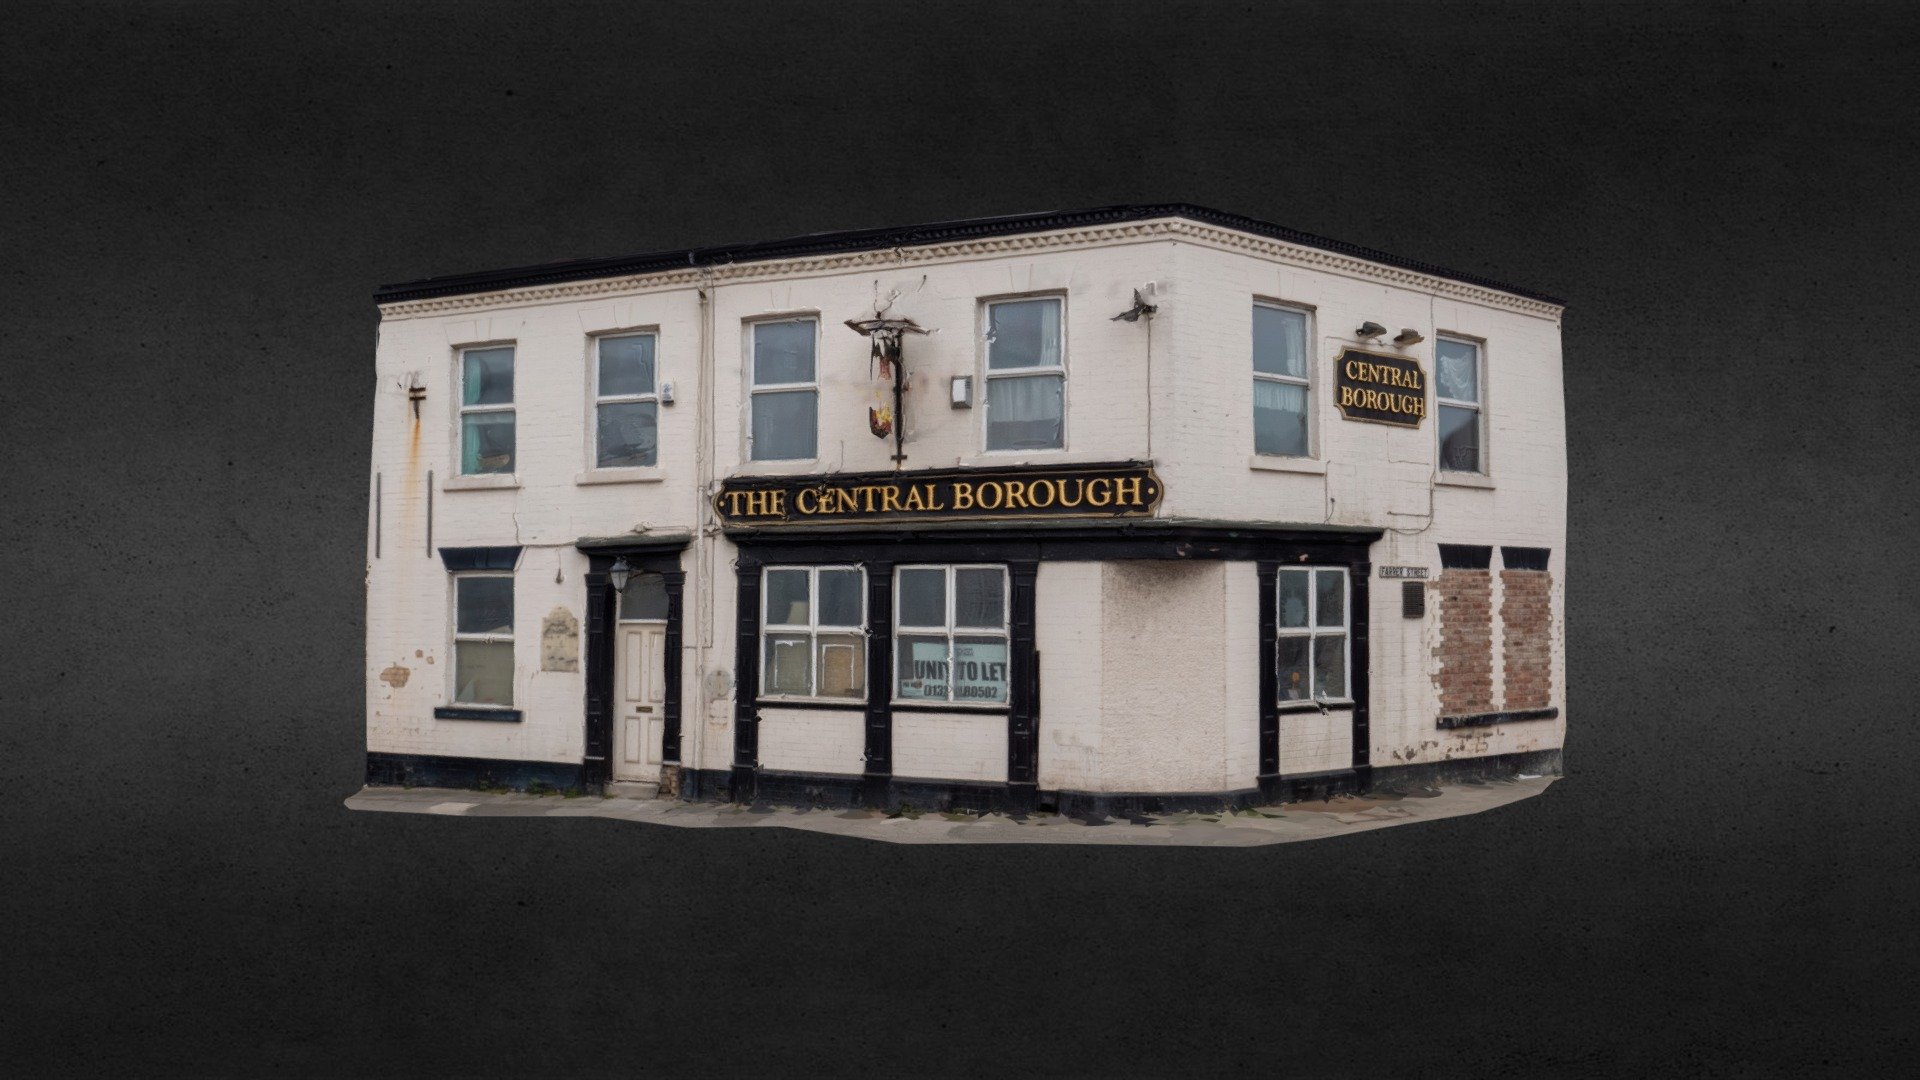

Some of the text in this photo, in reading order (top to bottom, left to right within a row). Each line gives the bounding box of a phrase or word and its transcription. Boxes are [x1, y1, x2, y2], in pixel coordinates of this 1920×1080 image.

[1346, 361, 1422, 390] CENTRAL
[1340, 386, 1425, 416] BOROUGH
[725, 477, 1143, 518] THE CENTRAL BOROUGH
[1406, 566, 1429, 577] STREET
[957, 661, 978, 681] TO
[981, 662, 1007, 682] LET
